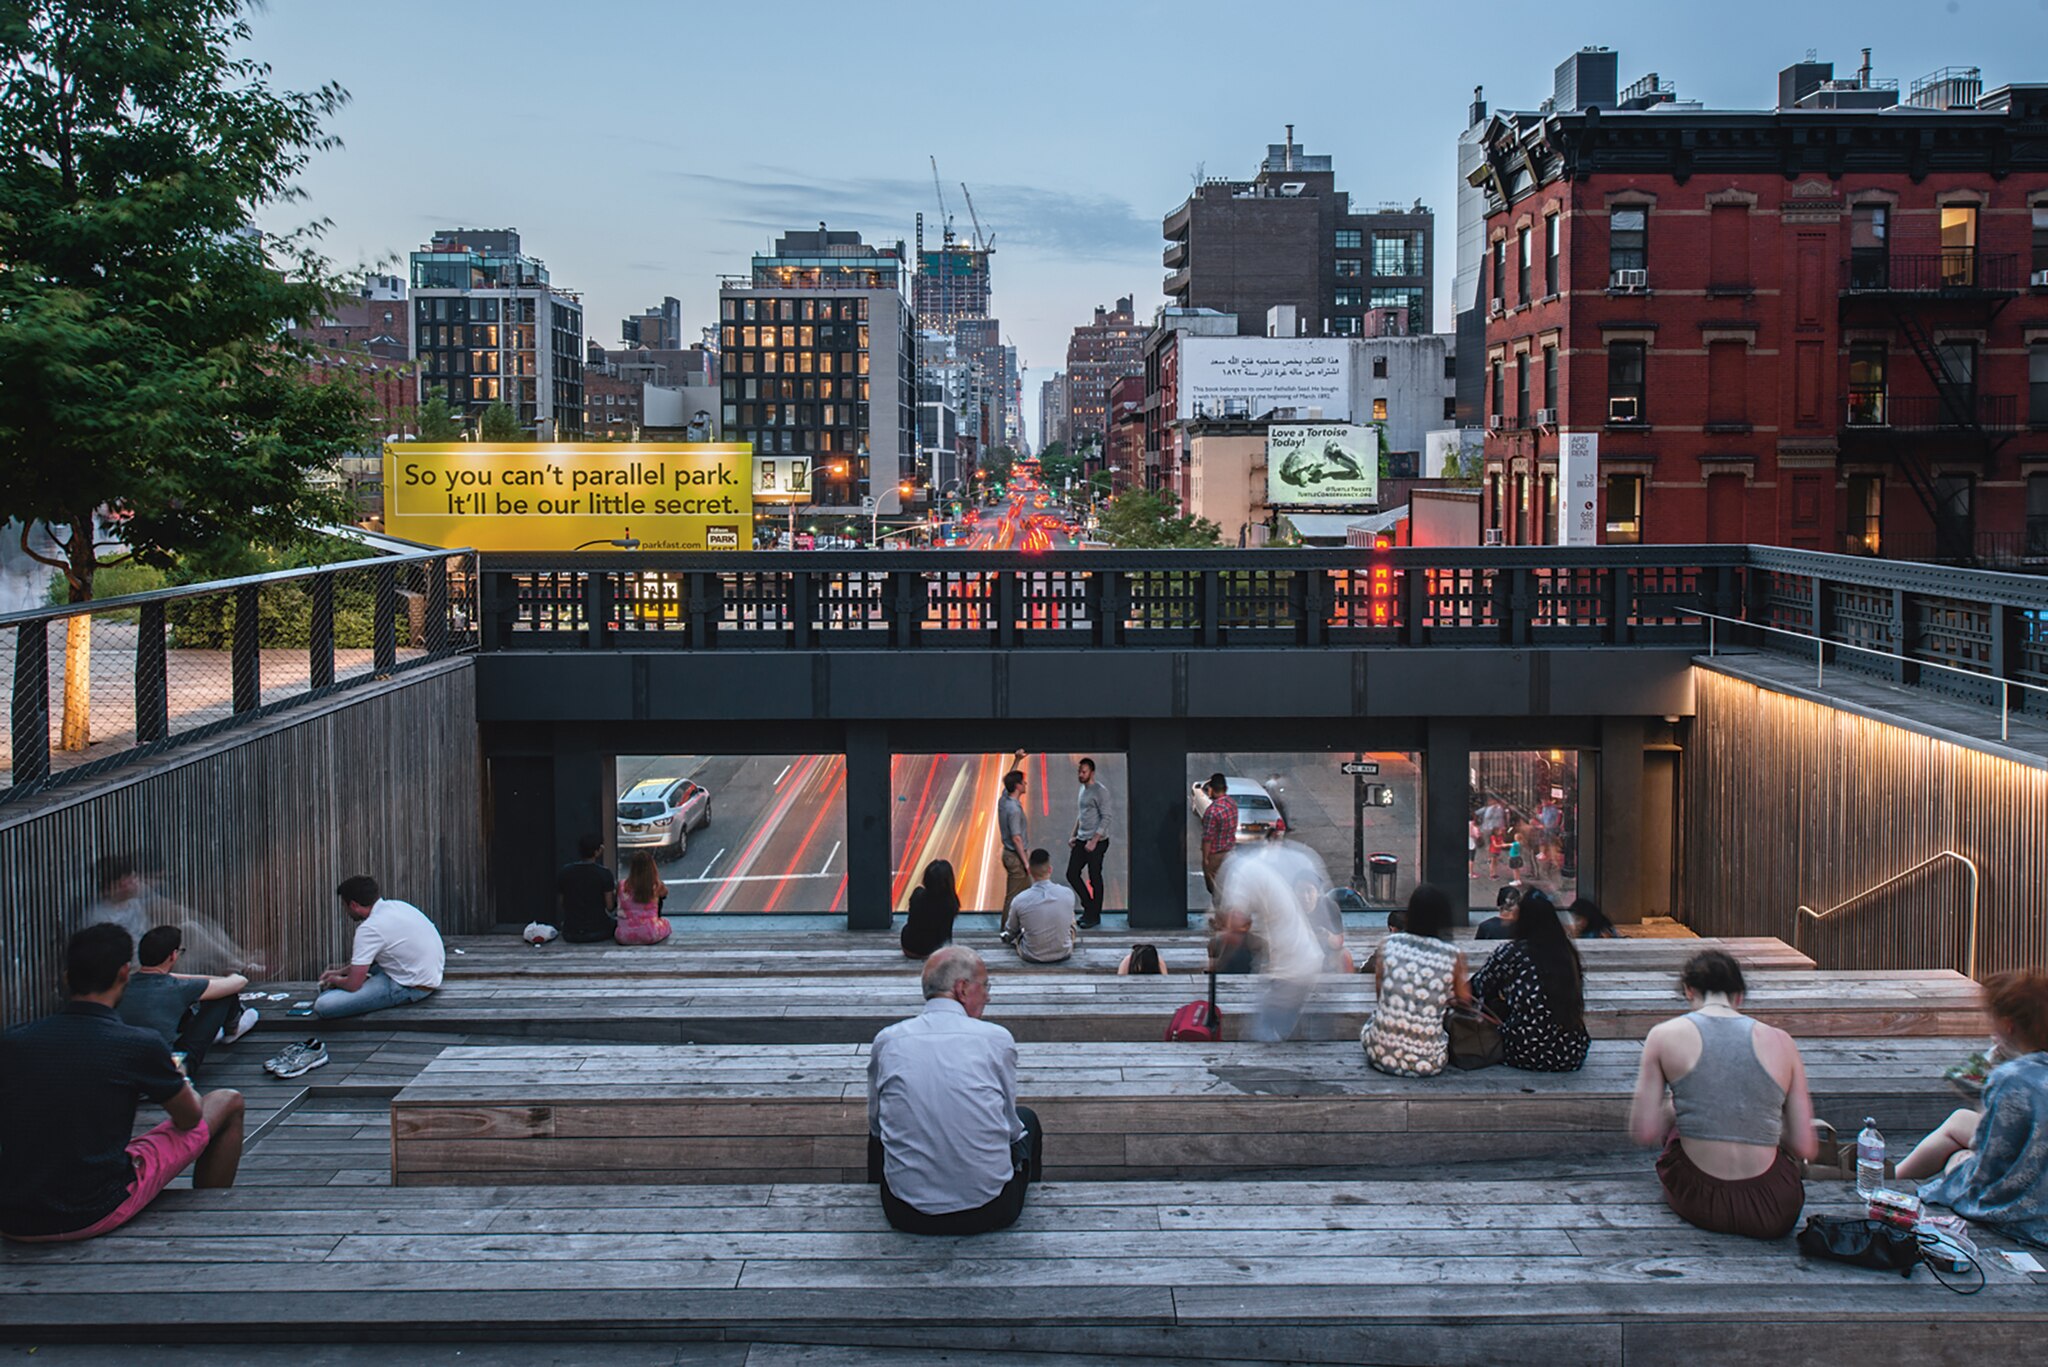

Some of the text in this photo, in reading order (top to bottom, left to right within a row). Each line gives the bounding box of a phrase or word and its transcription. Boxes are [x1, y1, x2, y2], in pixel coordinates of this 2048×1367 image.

[1271, 428, 1296, 438] Love
[1306, 428, 1348, 437] Tortoise
[1271, 438, 1306, 448] Today!
[405, 462, 739, 492] So you can't parallel park.
[448, 491, 739, 514] It'll be our little secret.
[710, 535, 736, 543] PARK
[641, 540, 702, 551] parkfast.com
